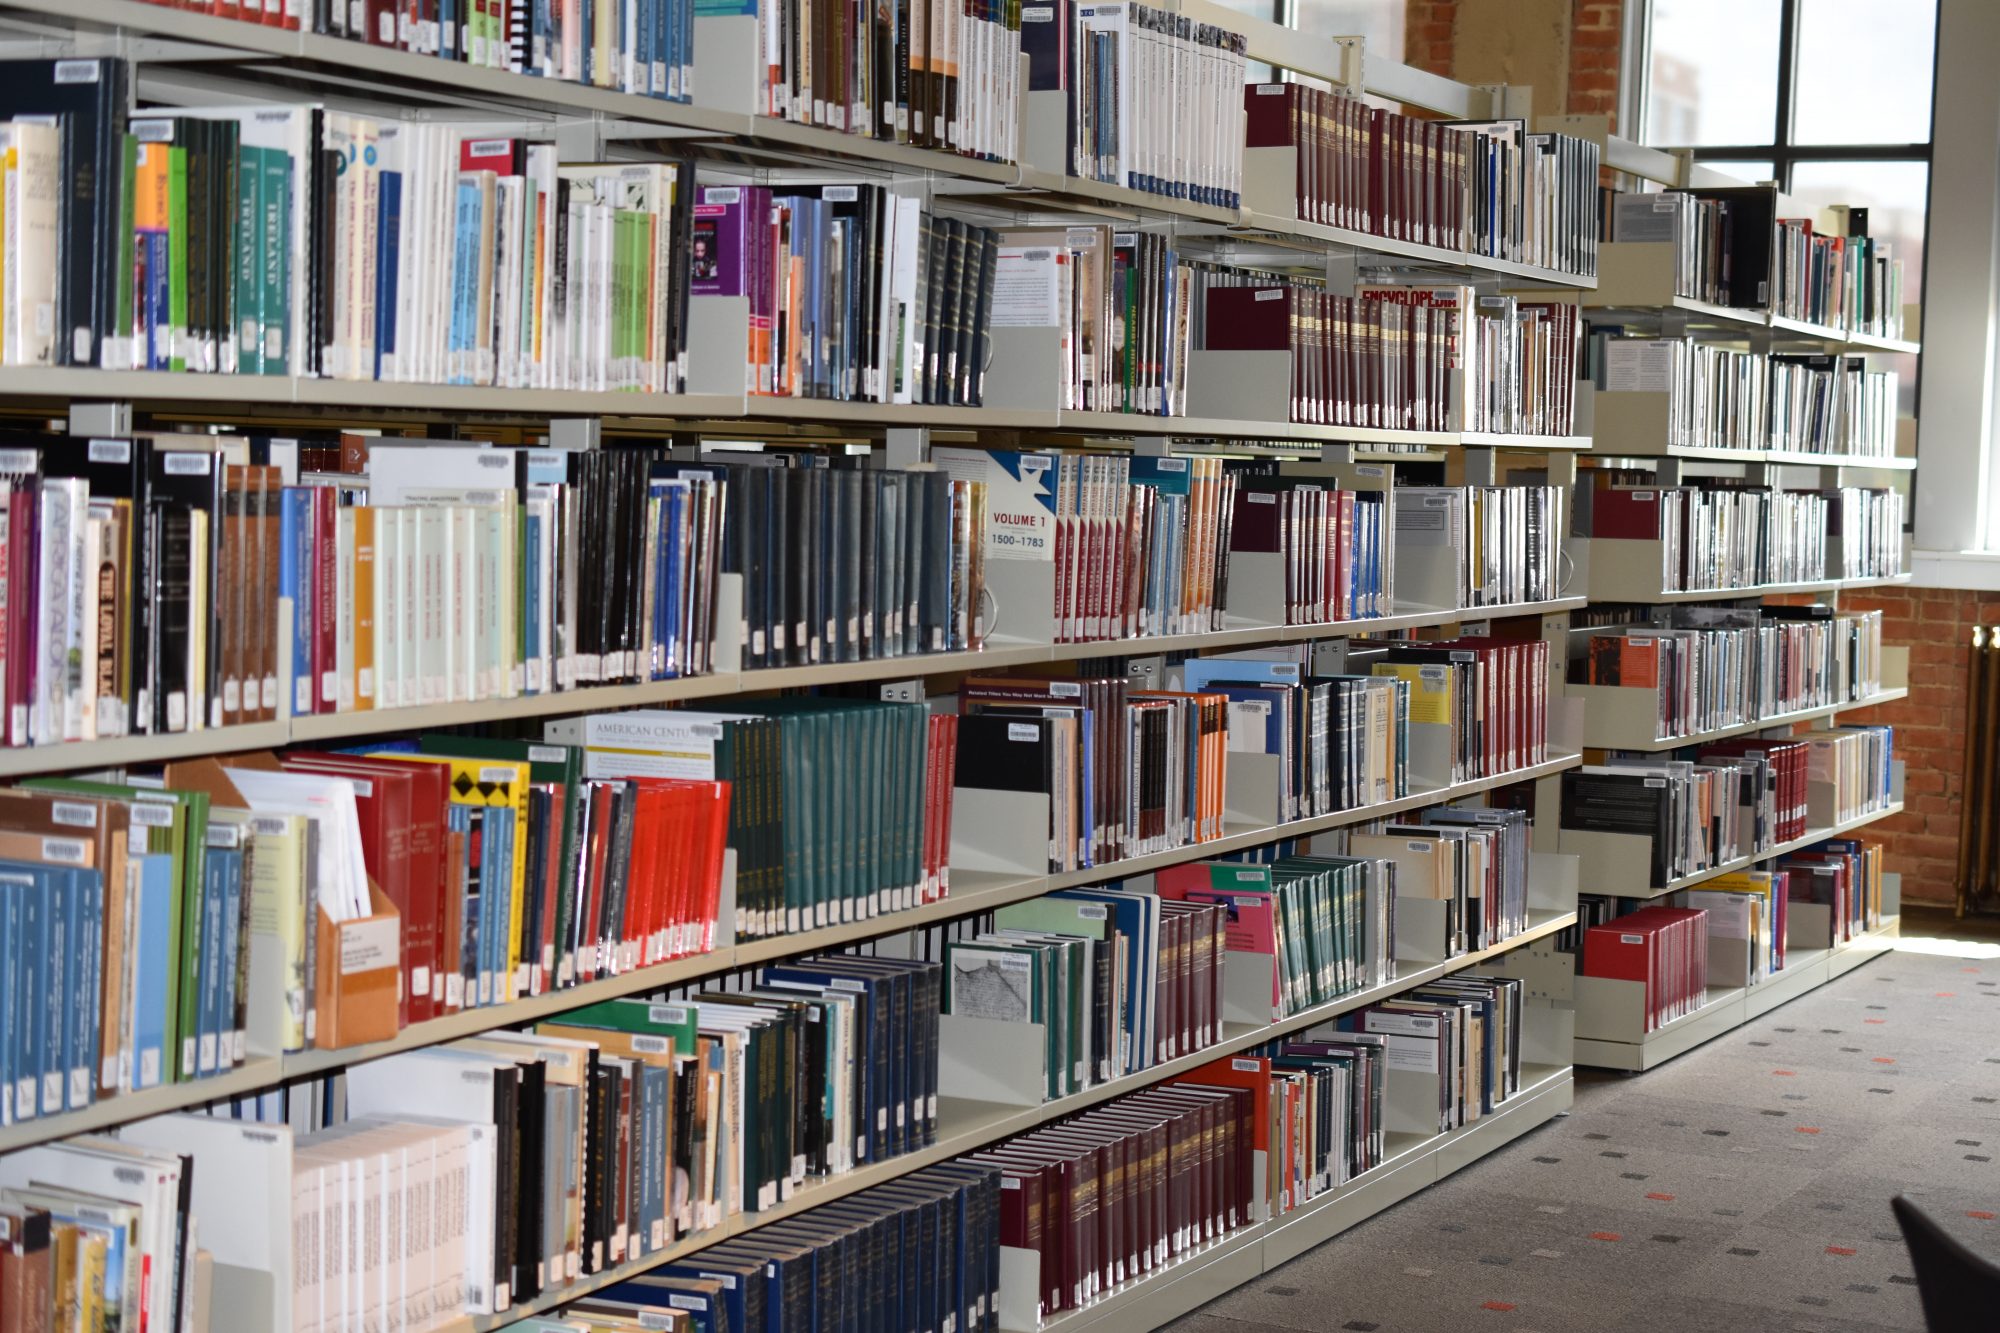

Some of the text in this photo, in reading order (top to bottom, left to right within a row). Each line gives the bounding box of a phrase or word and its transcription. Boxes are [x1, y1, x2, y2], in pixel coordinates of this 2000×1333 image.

[242, 198, 251, 280] IRELAND
[267, 203, 277, 285] IRELAND
[1362, 290, 1457, 308] ENCYCLOPE
[992, 534, 1044, 548] 1500–1783
[993, 513, 1045, 527] VOLUME 1
[98, 569, 114, 697] THE LOYAL BLAC
[596, 723, 690, 738] AMERICAN CENTU
[1132, 734, 1142, 827] Toward Freedom Land
